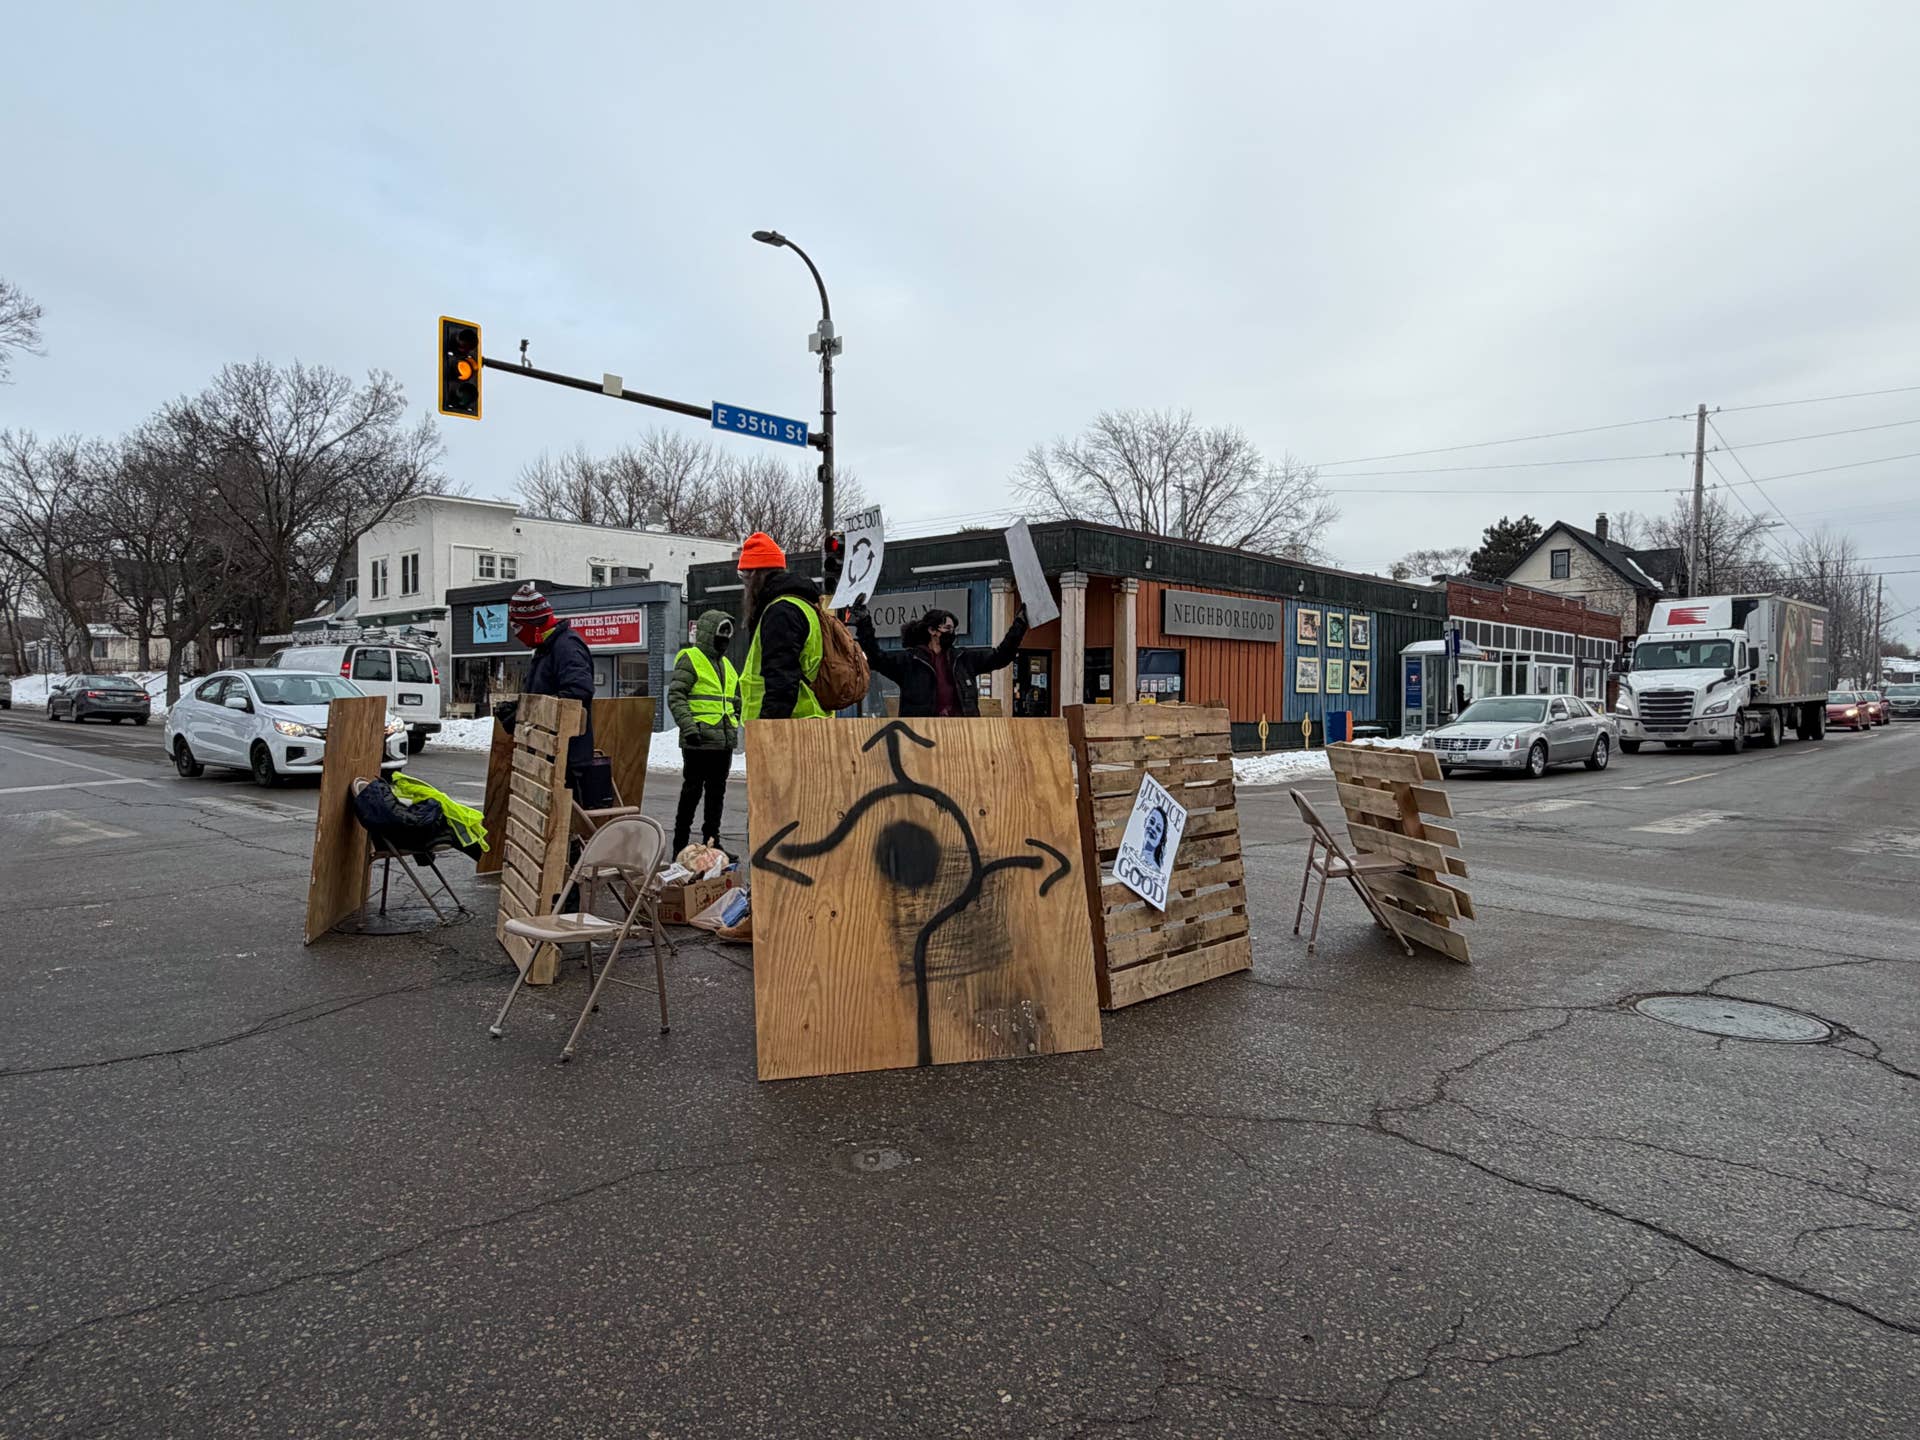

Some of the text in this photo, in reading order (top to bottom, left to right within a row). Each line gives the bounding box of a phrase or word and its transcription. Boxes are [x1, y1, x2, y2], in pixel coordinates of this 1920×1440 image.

[717, 408, 803, 442] E 35th St
[845, 509, 881, 534] ICE OUT
[570, 613, 639, 628] BROTHERS ELECTRIC
[1173, 603, 1275, 631] NEIGHBORHOOD
[1136, 797, 1151, 813] for
[1140, 779, 1185, 833] JUSTICE
[1117, 856, 1165, 904] GOOD
